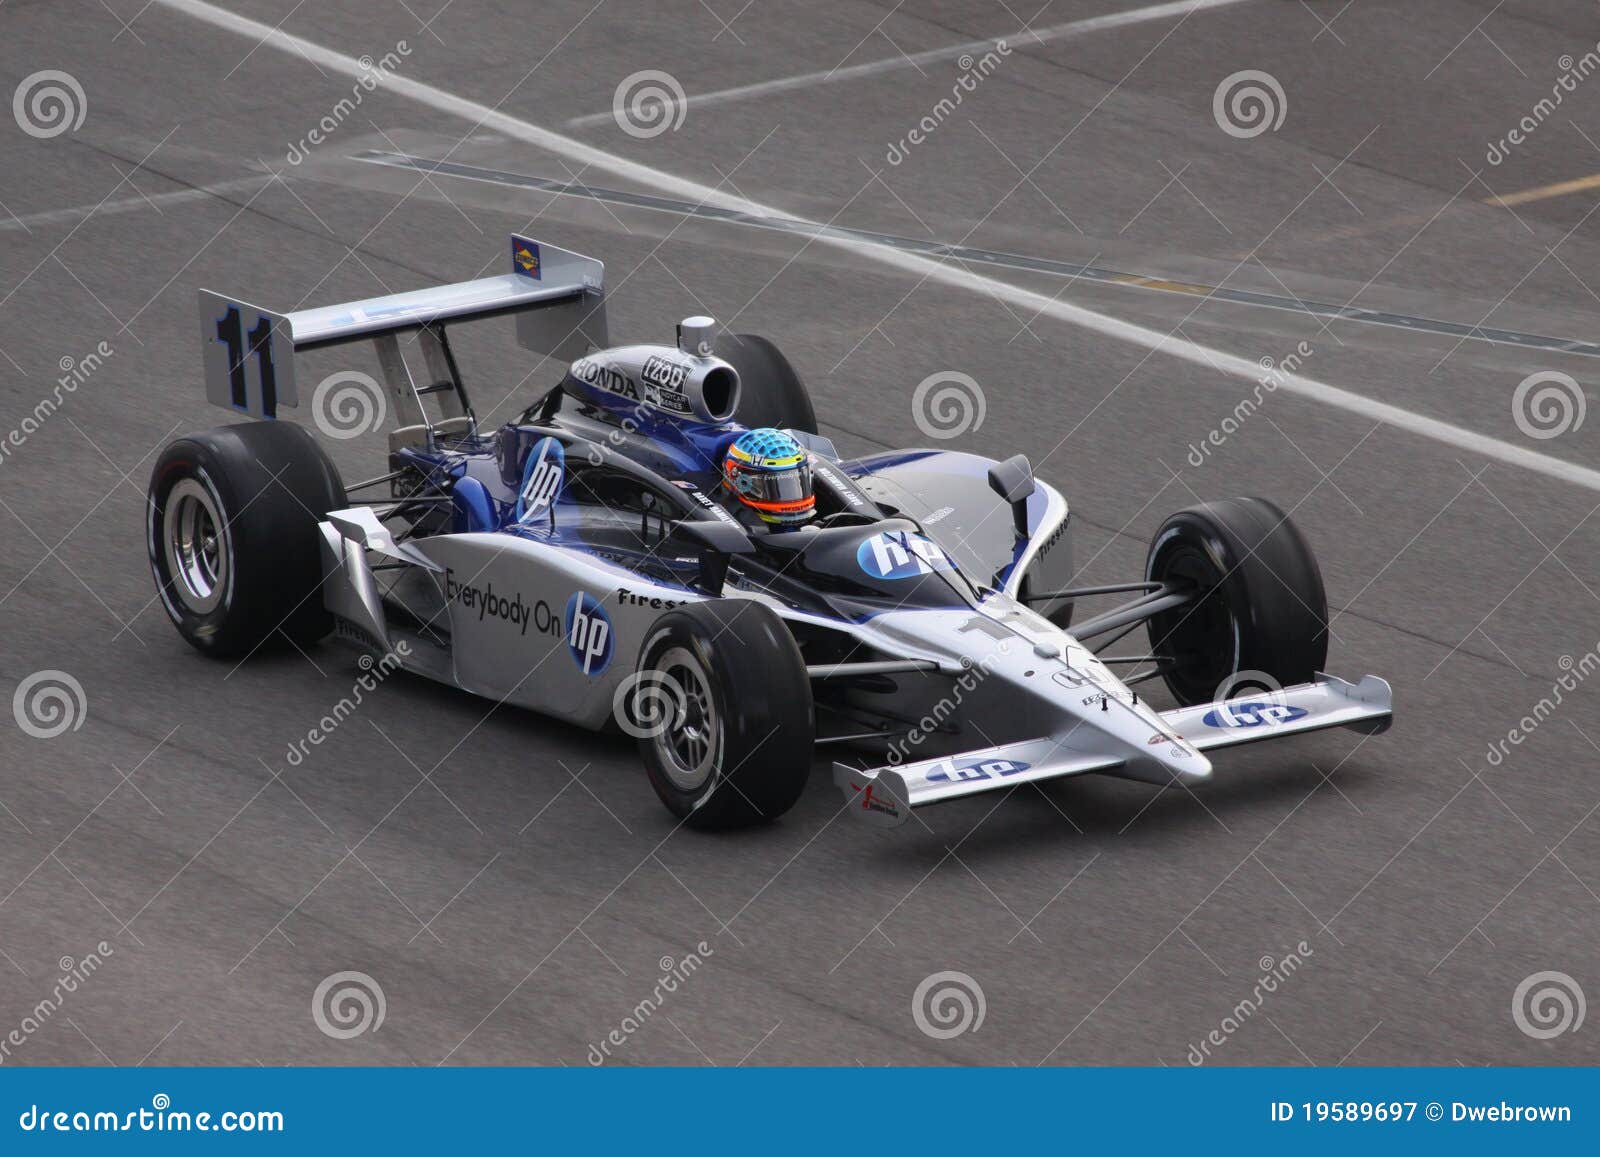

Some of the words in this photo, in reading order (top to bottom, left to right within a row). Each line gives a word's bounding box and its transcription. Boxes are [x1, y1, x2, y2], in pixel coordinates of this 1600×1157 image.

[216, 303, 277, 419] 11
[571, 359, 641, 401] HONDA
[643, 358, 684, 389] IZOD
[519, 437, 563, 523] hp
[869, 530, 947, 576] hp
[447, 568, 530, 635] Everybody
[534, 600, 561, 638] On
[569, 591, 609, 675] hp
[1217, 703, 1293, 728] hp
[939, 759, 1016, 782] hp
